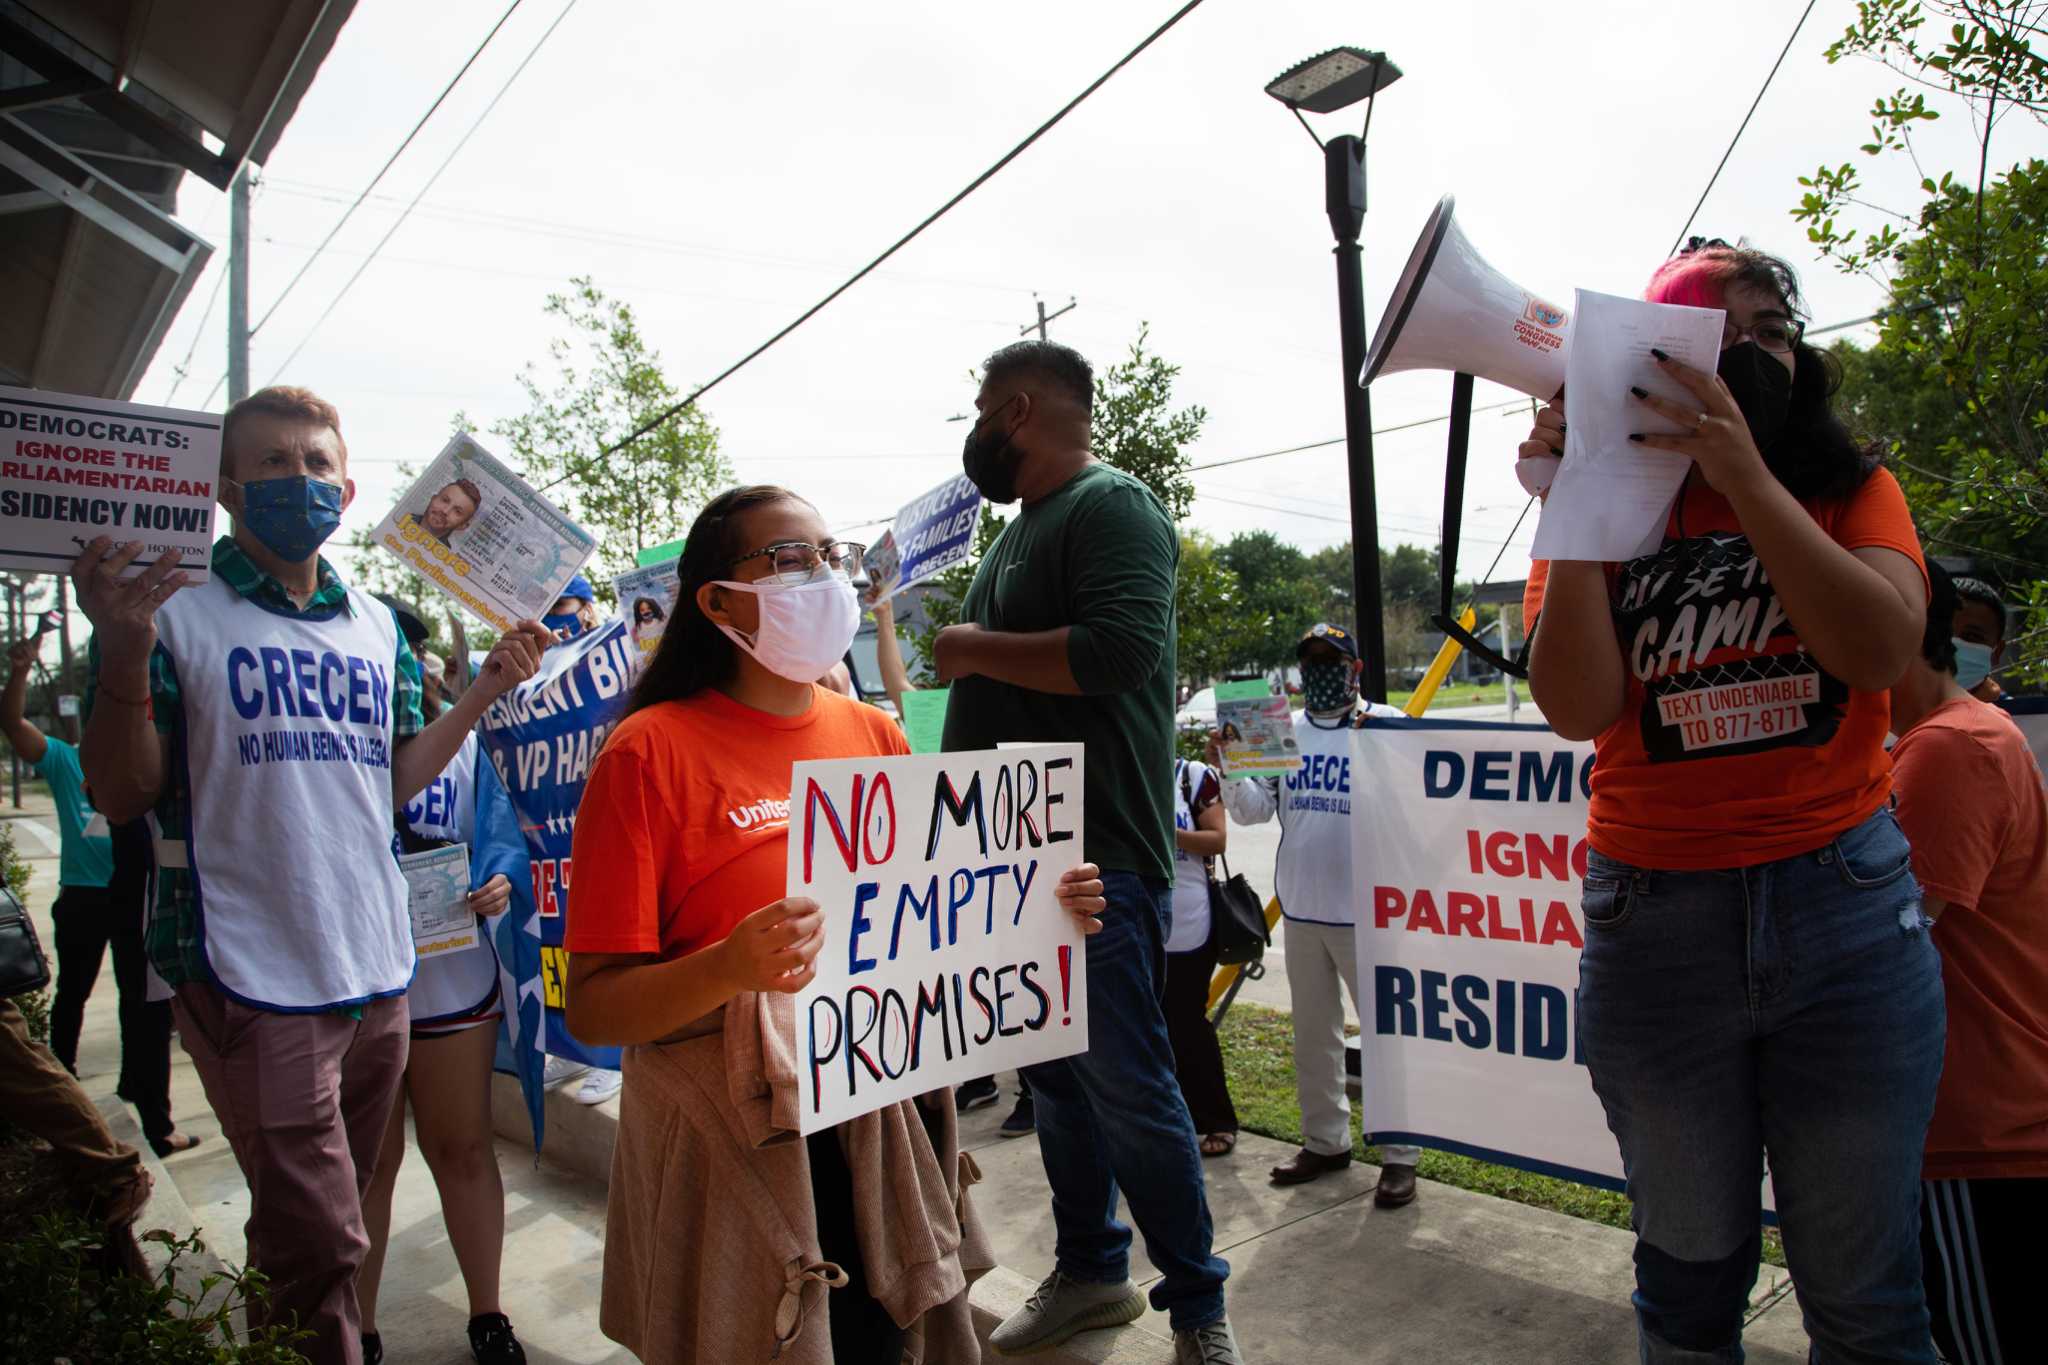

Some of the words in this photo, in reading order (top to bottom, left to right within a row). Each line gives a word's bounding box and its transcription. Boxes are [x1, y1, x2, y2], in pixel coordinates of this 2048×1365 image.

[1514, 324, 1560, 349] CONGRESS
[0, 410, 190, 450] DEMOCRATS:
[15, 440, 115, 468] IGNORE
[121, 452, 170, 473] THE
[0, 461, 211, 497] RLIAMENTARIAN
[1, 490, 127, 526] SIDENCY
[133, 502, 208, 533] NOW!
[909, 504, 978, 560] FAMILIES
[147, 543, 205, 556] HOUTON
[396, 513, 471, 577] Ignore
[911, 541, 968, 580] CRECEN
[228, 646, 389, 729] CRECEN
[1661, 694, 1703, 721] TEXT
[1709, 678, 1813, 712] UNDENIABLE
[1683, 719, 1710, 746] TO
[1715, 706, 1799, 741] 877-877
[238, 734, 260, 765] NO
[264, 731, 310, 763] HUMAN
[313, 731, 348, 762] BEING
[516, 740, 550, 792] VP
[803, 771, 897, 884] NO
[925, 757, 1074, 862] MORE
[848, 860, 1038, 975] EMPTY
[1373, 886, 1585, 949] PARLIA
[808, 945, 1072, 1114] PROMISES!
[1374, 965, 1586, 1066] RESID
